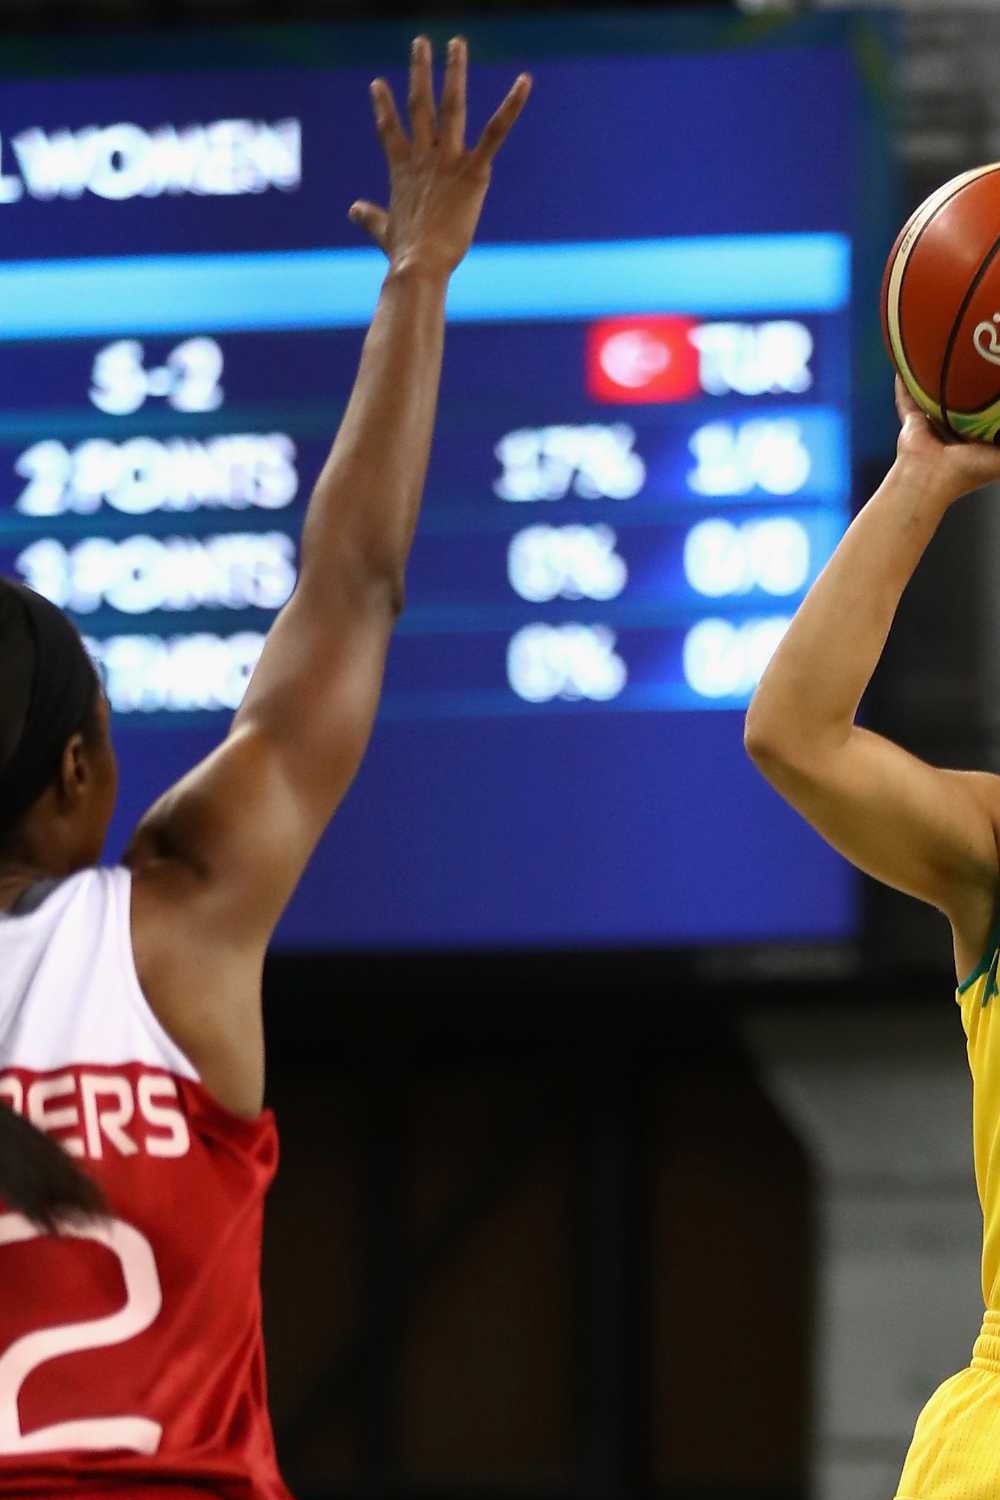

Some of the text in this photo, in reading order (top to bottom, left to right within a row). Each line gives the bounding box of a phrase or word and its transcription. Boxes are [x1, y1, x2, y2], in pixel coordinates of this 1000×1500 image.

[11, 116, 302, 201] WOMEN
[687, 320, 814, 396] TUR
[68, 431, 299, 516] POINTS
[0, 1072, 191, 1160] ERS
[0, 1210, 162, 1456] 2
